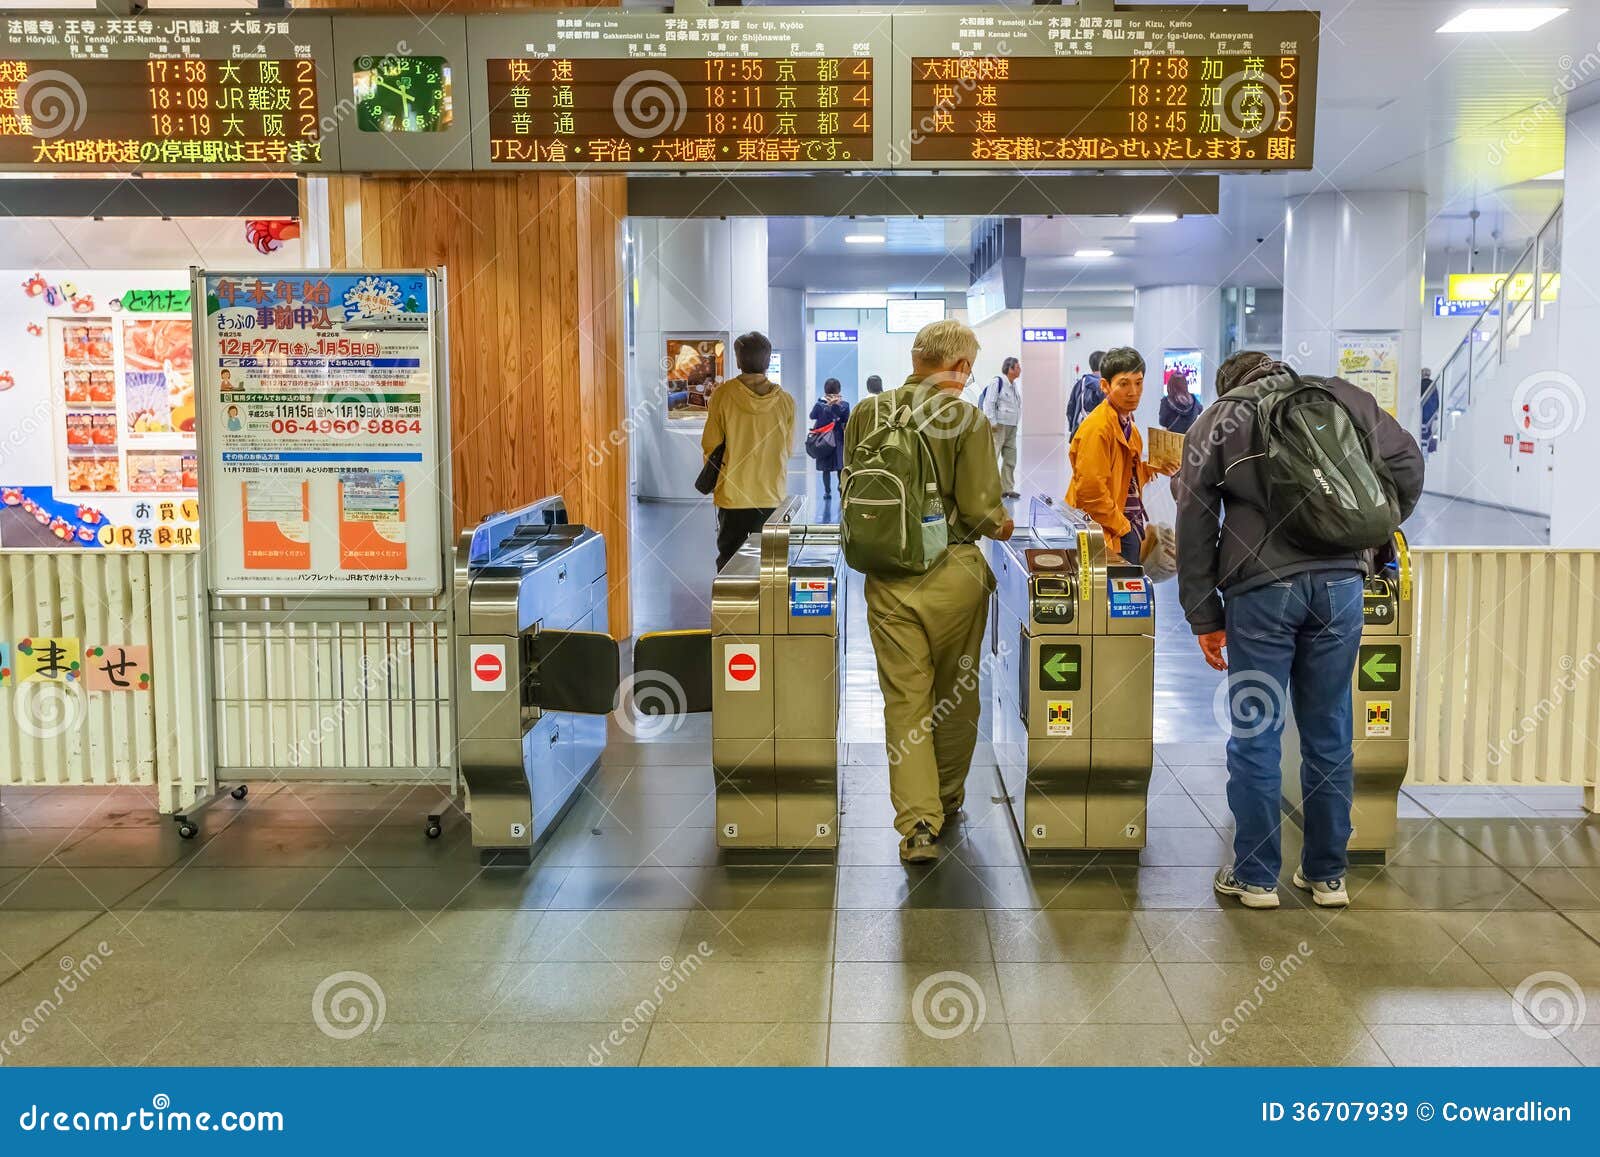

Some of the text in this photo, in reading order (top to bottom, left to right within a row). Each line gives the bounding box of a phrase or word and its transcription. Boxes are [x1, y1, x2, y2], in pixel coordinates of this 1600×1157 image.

[747, 21, 760, 30] for
[997, 19, 1026, 27] Yamatoji
[1129, 20, 1140, 28] for
[1145, 20, 1165, 29] Kizu,
[1169, 20, 1192, 28] Kamo
[9, 35, 21, 43] for
[726, 33, 738, 41] for
[1152, 32, 1163, 40] for
[1210, 32, 1254, 41] Kameyama
[533, 51, 549, 59] Type
[147, 61, 206, 83] 17:58
[218, 60, 282, 83] 大阪
[296, 61, 313, 82] 2
[415, 65, 421, 74] 1
[508, 58, 871, 82] 快速 17:55 京都 4
[922, 57, 1296, 80] 大和路快速 17:58 加茂 5
[427, 74, 436, 83] 2
[0, 87, 315, 110] 速 18:09 JR難波 2
[434, 90, 442, 99] 3
[510, 85, 871, 108] 普通 18:11 京都 4
[933, 83, 1294, 107] 快速 18:22 加茂 5
[374, 106, 382, 115] 8
[428, 105, 437, 114] 4
[388, 115, 396, 124] 7
[402, 118, 410, 127] 6
[416, 115, 424, 125] 5
[511, 111, 871, 135] 普通 18:40 京都 4
[933, 110, 1293, 134] 快速 18:45 加茂 5
[0, 114, 317, 137] 快速 18:19 大阪 2
[217, 278, 332, 304] 年末年始
[409, 282, 423, 290] JR
[271, 419, 422, 434] 06-4960-9864
[1312, 468, 1333, 495] NIKE
[104, 526, 192, 545] JR奈良駅
[513, 826, 520, 836] 5
[727, 826, 734, 836] 5
[819, 826, 826, 836] 6
[1036, 827, 1043, 837] 6
[1128, 827, 1135, 837] 7
